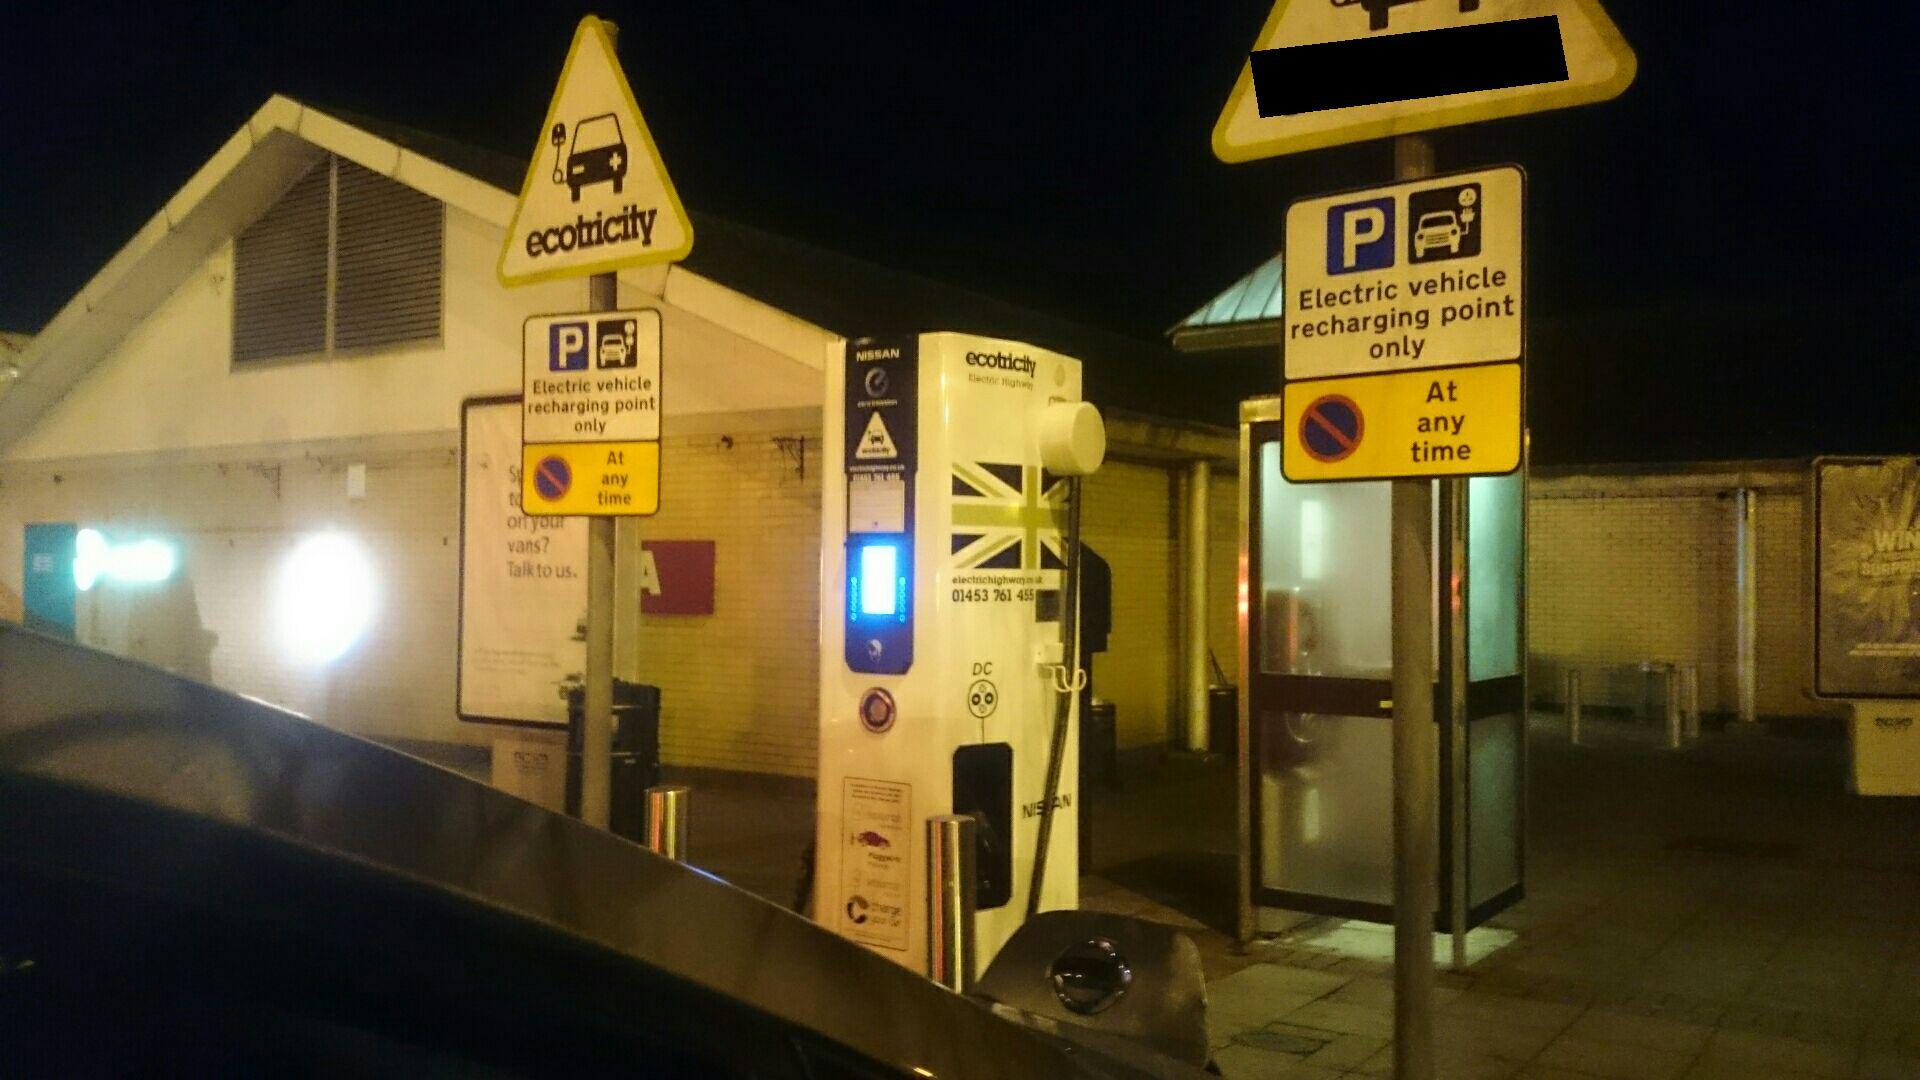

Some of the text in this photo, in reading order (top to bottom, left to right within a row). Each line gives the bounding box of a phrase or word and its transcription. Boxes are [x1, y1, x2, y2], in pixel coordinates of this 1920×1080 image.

[526, 204, 657, 257] ecotricity
[1343, 207, 1385, 269] P
[1299, 266, 1507, 311] Electric vehicle
[1291, 294, 1515, 340] recharging point
[558, 326, 584, 369] P
[856, 348, 900, 362] NISSAN
[1369, 335, 1425, 359] only
[966, 351, 1036, 378] ecotricity
[533, 376, 652, 395] Electric vehicle
[968, 373, 997, 386] Electric
[1425, 381, 1457, 402] At
[528, 396, 656, 415] recharging point
[574, 417, 607, 435] only
[1417, 414, 1465, 435] any
[606, 450, 624, 466] At
[1411, 441, 1471, 463] time
[601, 473, 629, 488] any
[598, 491, 632, 505] time
[507, 535, 550, 554] vans?
[507, 561, 577, 578] Talk to us.
[952, 589, 989, 602] 01453
[993, 589, 1012, 602] 761
[972, 661, 993, 676] DC
[1022, 793, 1072, 818] NISAN
